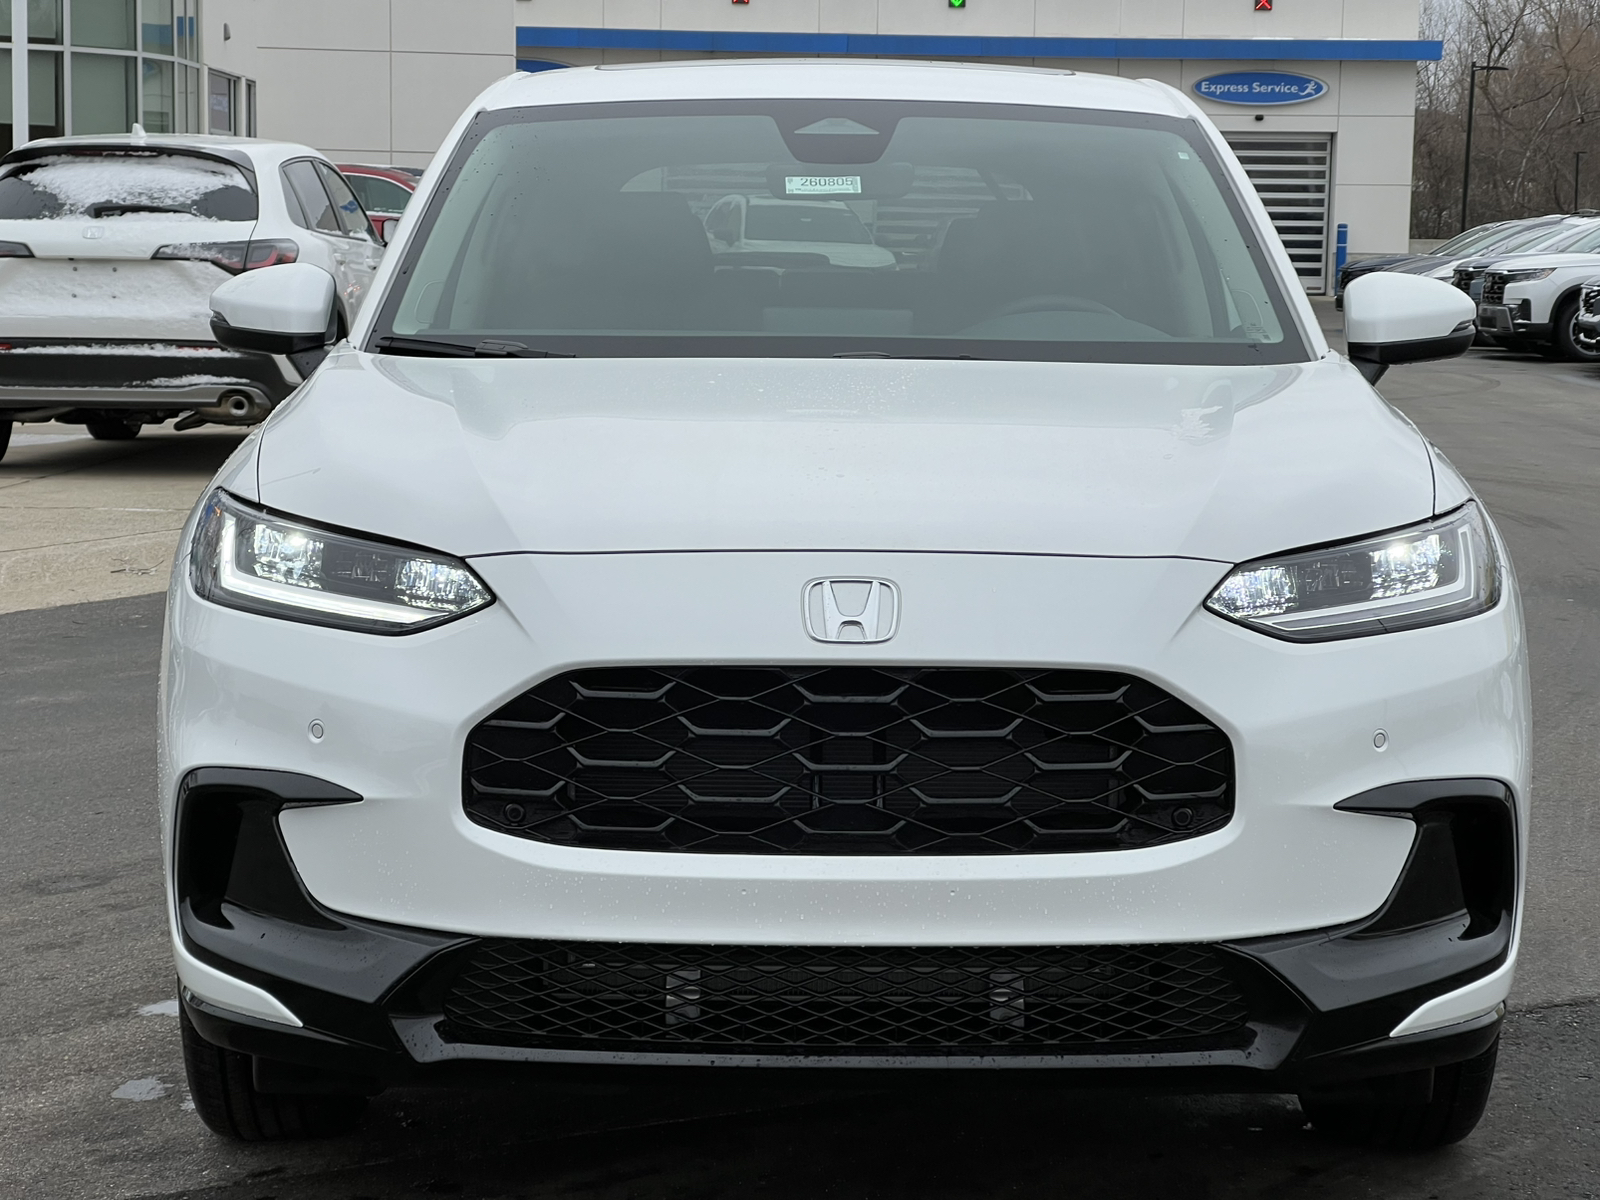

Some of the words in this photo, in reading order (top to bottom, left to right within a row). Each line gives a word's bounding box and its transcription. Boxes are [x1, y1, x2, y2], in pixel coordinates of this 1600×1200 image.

[1201, 81, 1249, 95] Express
[1252, 82, 1299, 93] Service
[800, 177, 853, 187] 260805
